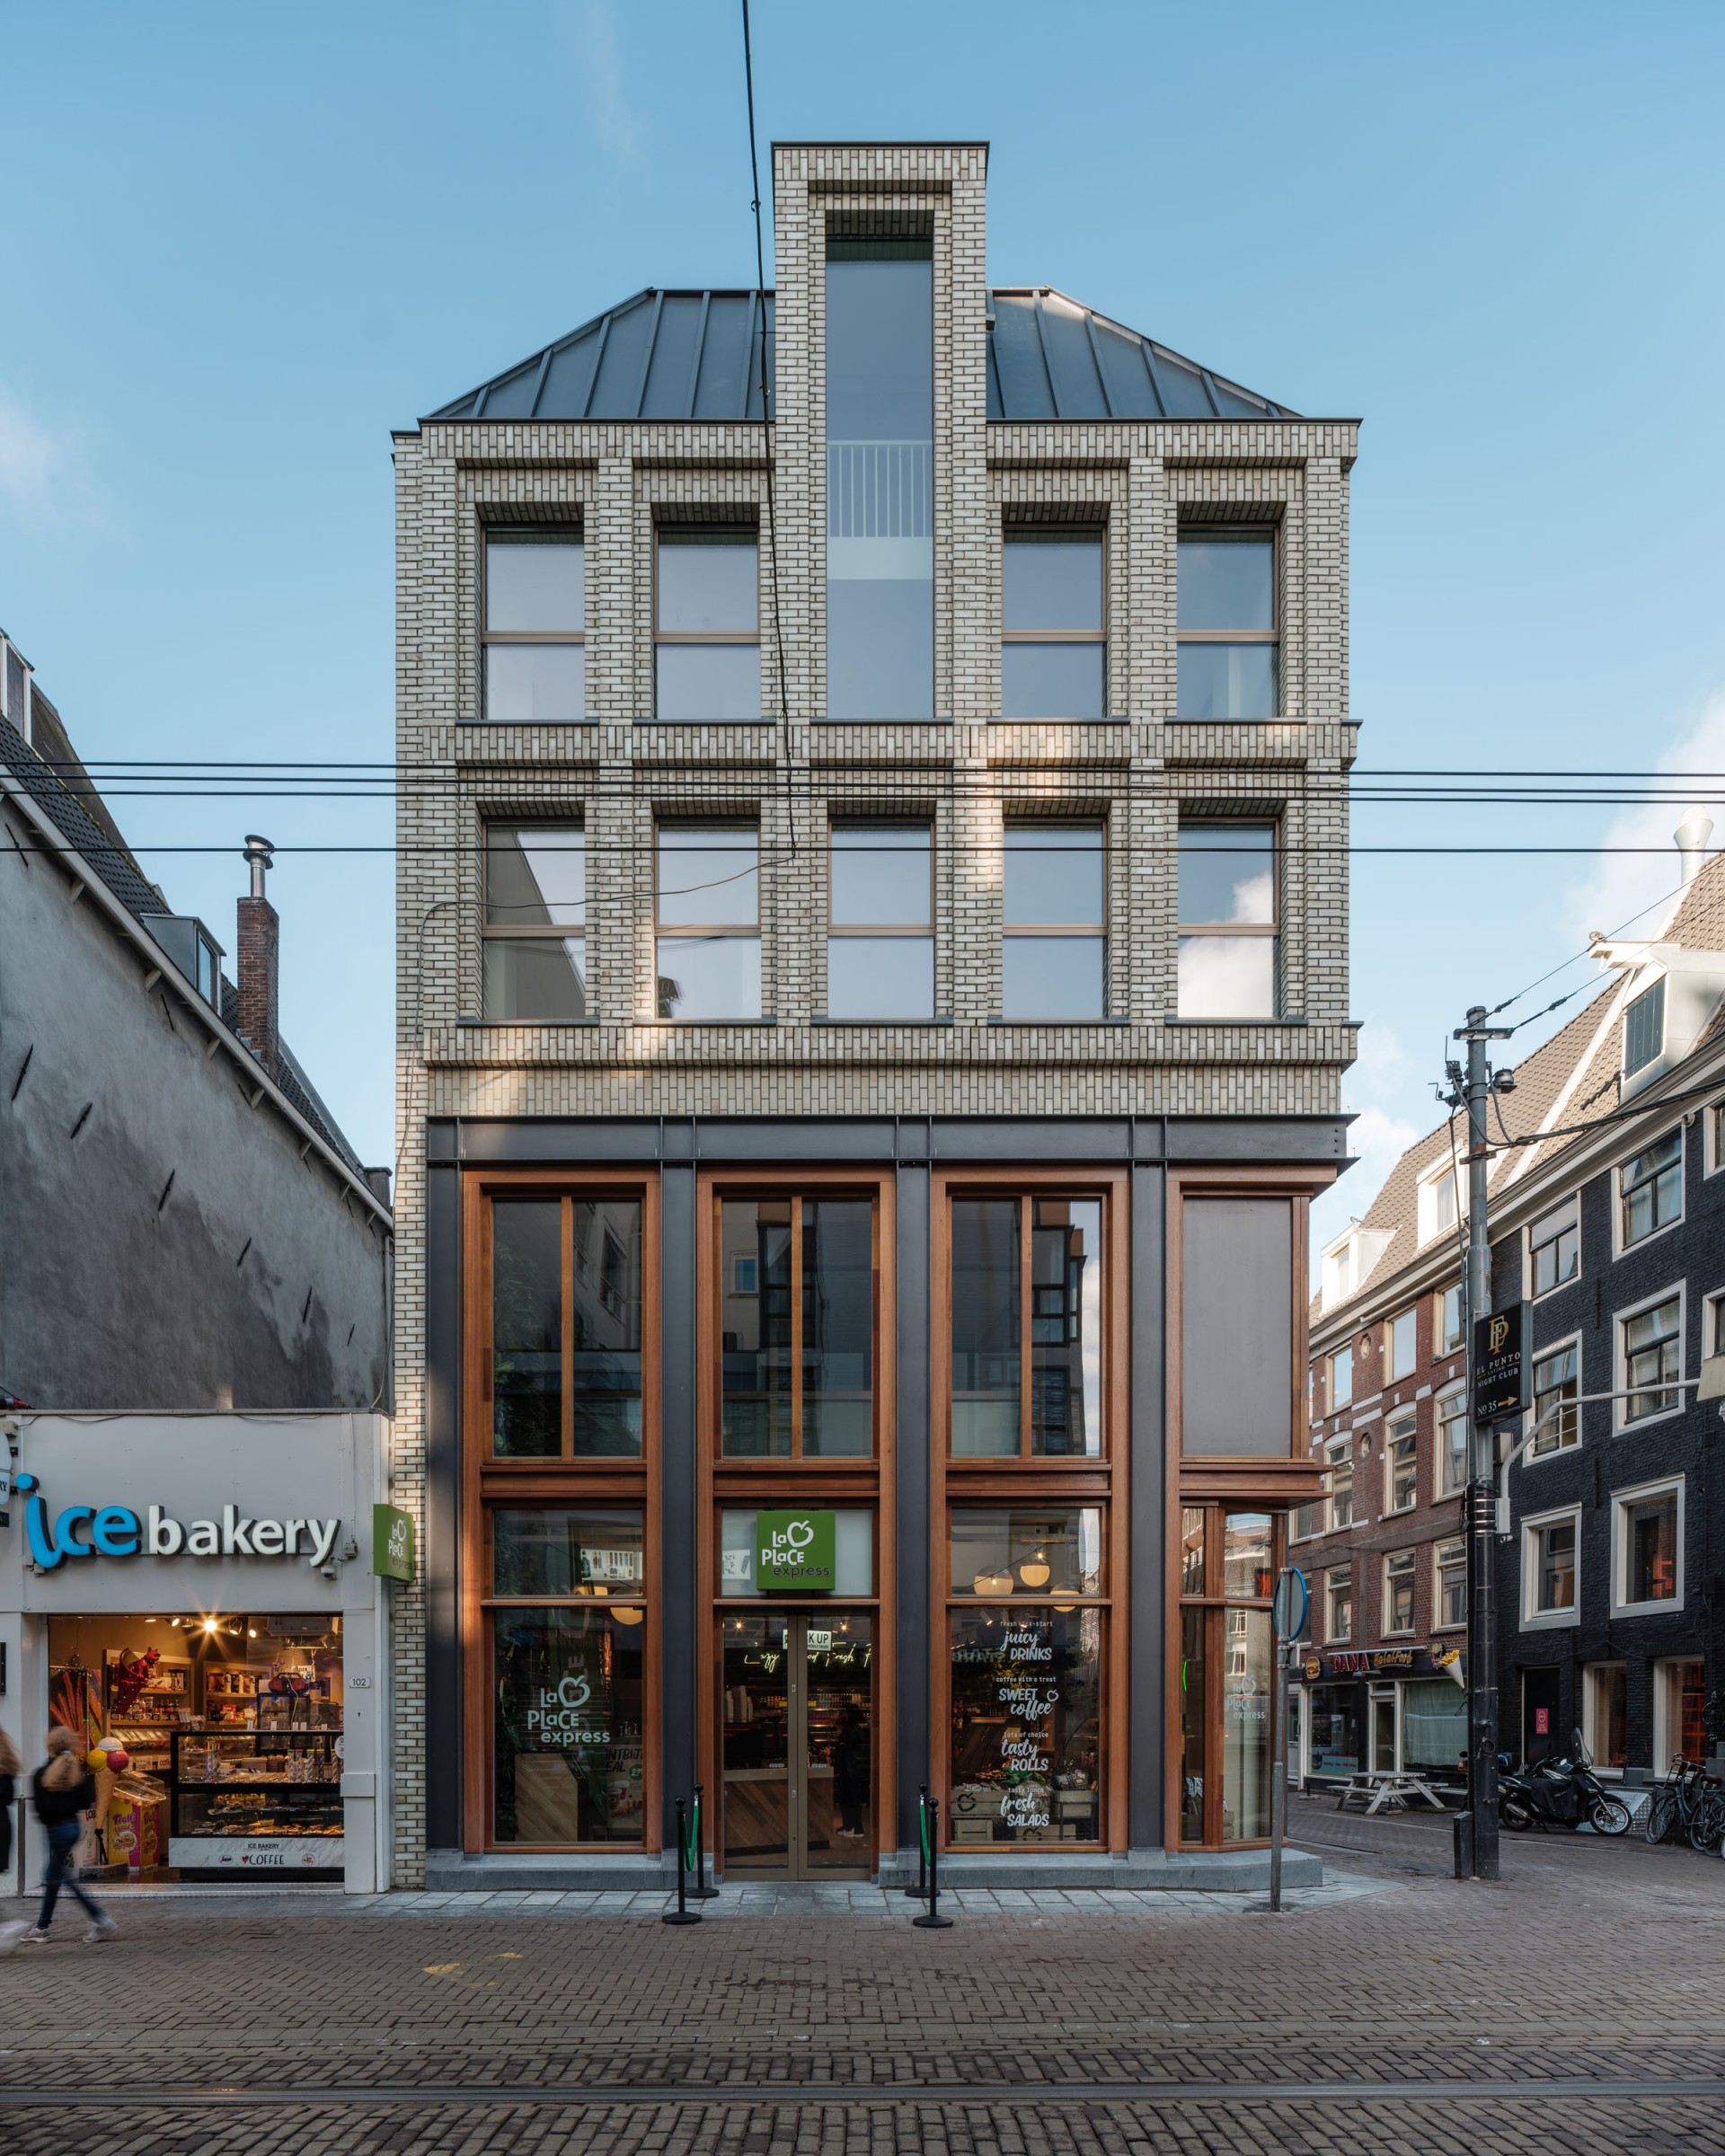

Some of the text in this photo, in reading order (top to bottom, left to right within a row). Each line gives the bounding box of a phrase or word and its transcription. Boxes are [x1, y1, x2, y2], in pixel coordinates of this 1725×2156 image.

[1476, 1352, 1520, 1375] EL PUNTO
[1477, 1367, 1518, 1388] NIGHT CLUB
[1488, 1401, 1497, 1413] 35
[16, 1472, 341, 1568] ice bakery
[772, 1530, 787, 1548] La
[773, 1566, 830, 1579] express
[817, 1633, 829, 1644] UP
[999, 1629, 1039, 1652] juicy
[1010, 1647, 1052, 1660] DRINKS
[1331, 1653, 1370, 1673] DANA
[352, 1678, 367, 1686] 102
[540, 1688, 558, 1708] La
[998, 1687, 1039, 1701] SWEET
[1010, 1700, 1053, 1721] coffee
[1233, 1711, 1265, 1721] express
[540, 1731, 611, 1747] express
[1001, 1738, 1040, 1761] tasty
[1011, 1758, 1048, 1772] ROLLS
[1000, 1791, 1036, 1816] fresh
[1006, 1813, 1050, 1827] SALADS
[249, 1854, 285, 1865] COFFEE
